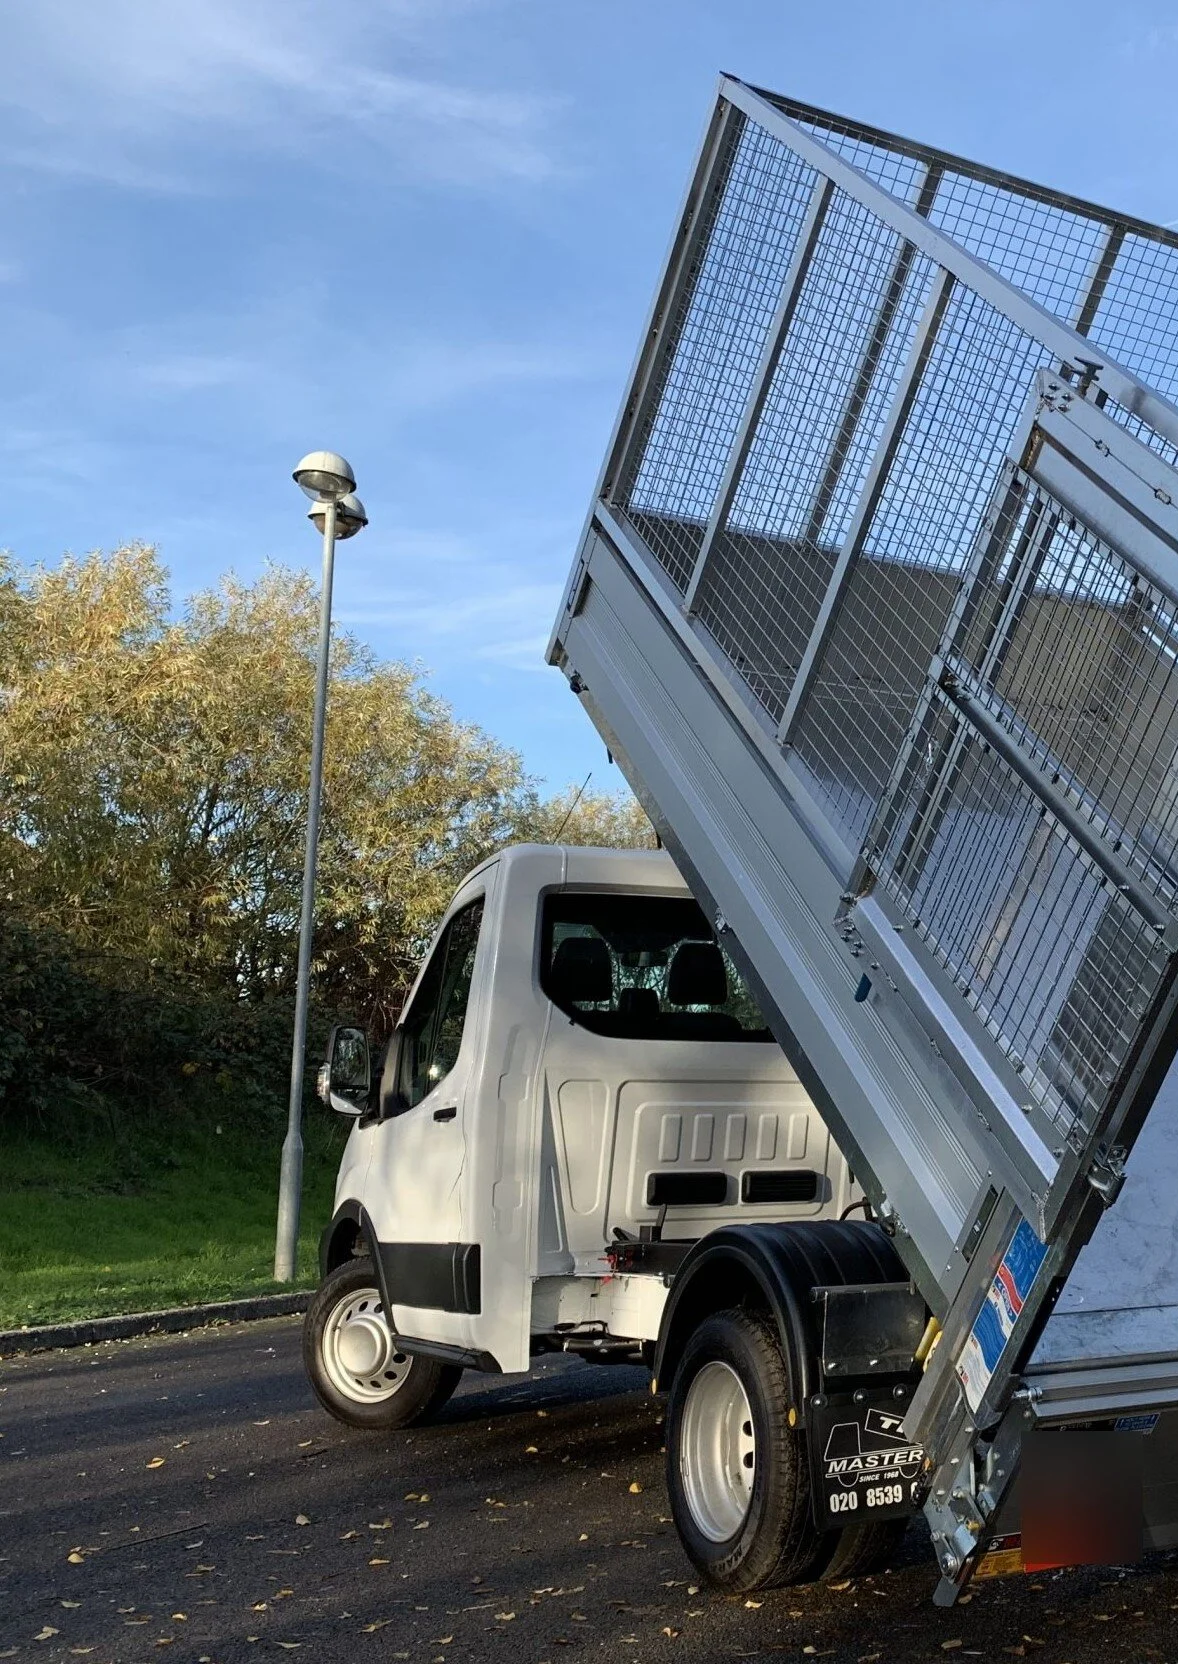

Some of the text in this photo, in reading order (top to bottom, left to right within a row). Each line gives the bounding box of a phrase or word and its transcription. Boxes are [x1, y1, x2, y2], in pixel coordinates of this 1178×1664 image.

[828, 1450, 924, 1473] MASTER
[859, 1474, 880, 1483] SINCE
[829, 1491, 858, 1513] 020
[866, 1484, 903, 1507] 8539
